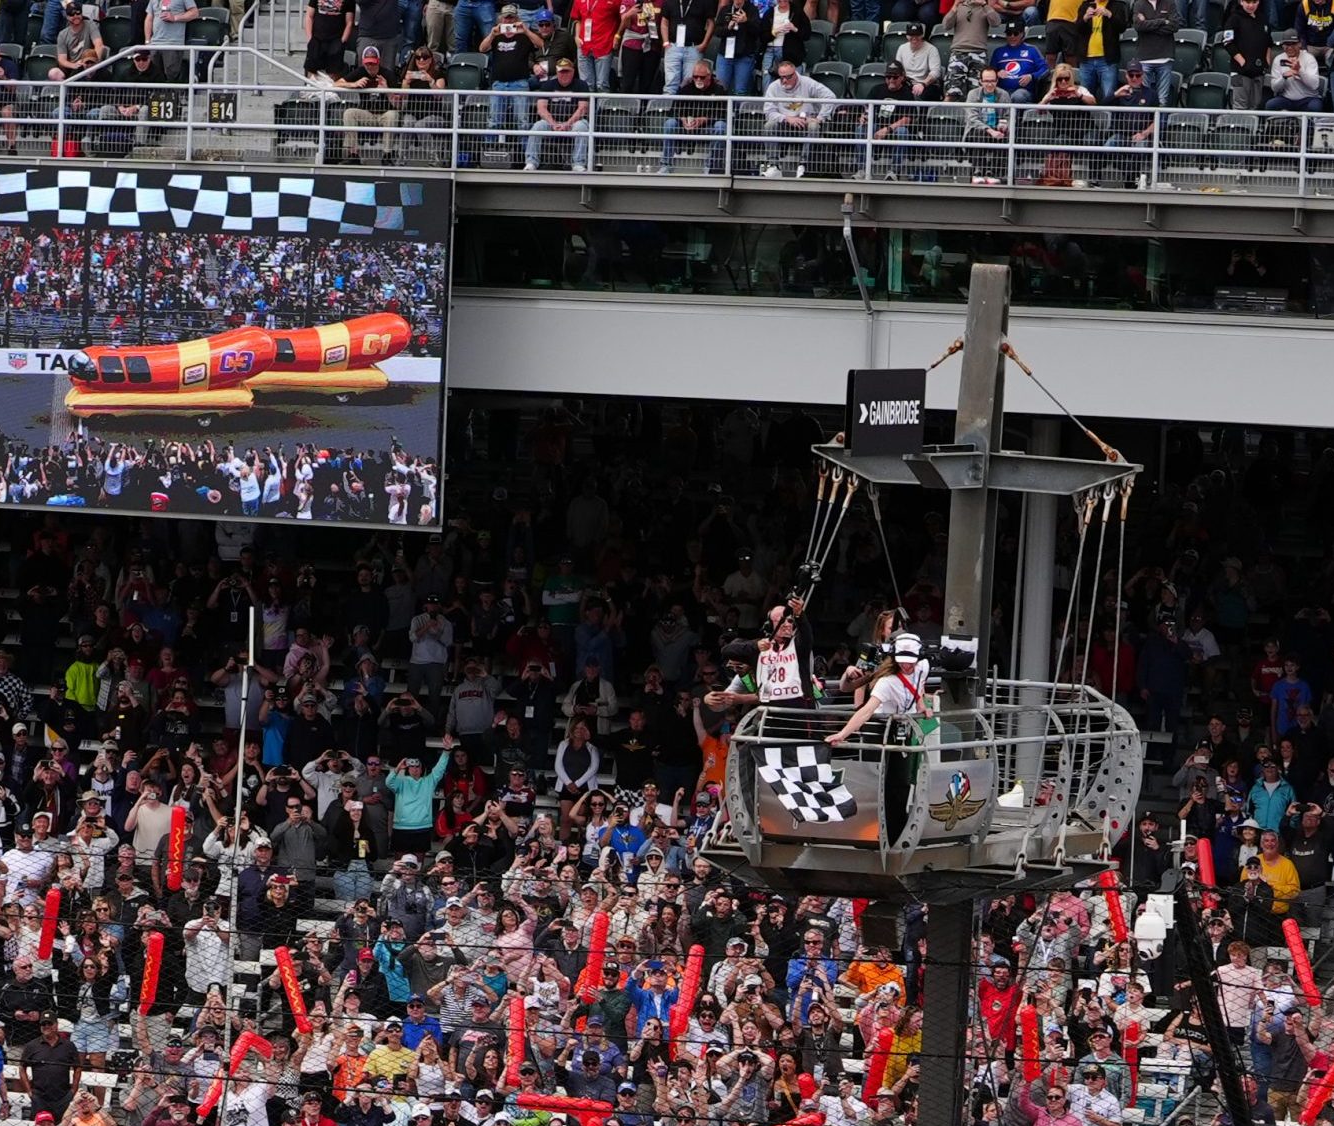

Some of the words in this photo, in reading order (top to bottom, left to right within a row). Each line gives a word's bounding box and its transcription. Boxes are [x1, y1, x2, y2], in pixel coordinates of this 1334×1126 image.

[159, 101, 174, 119] 13
[219, 102, 234, 120] 14
[35, 353, 69, 370] TA
[869, 400, 920, 425] GAINBRIDGE
